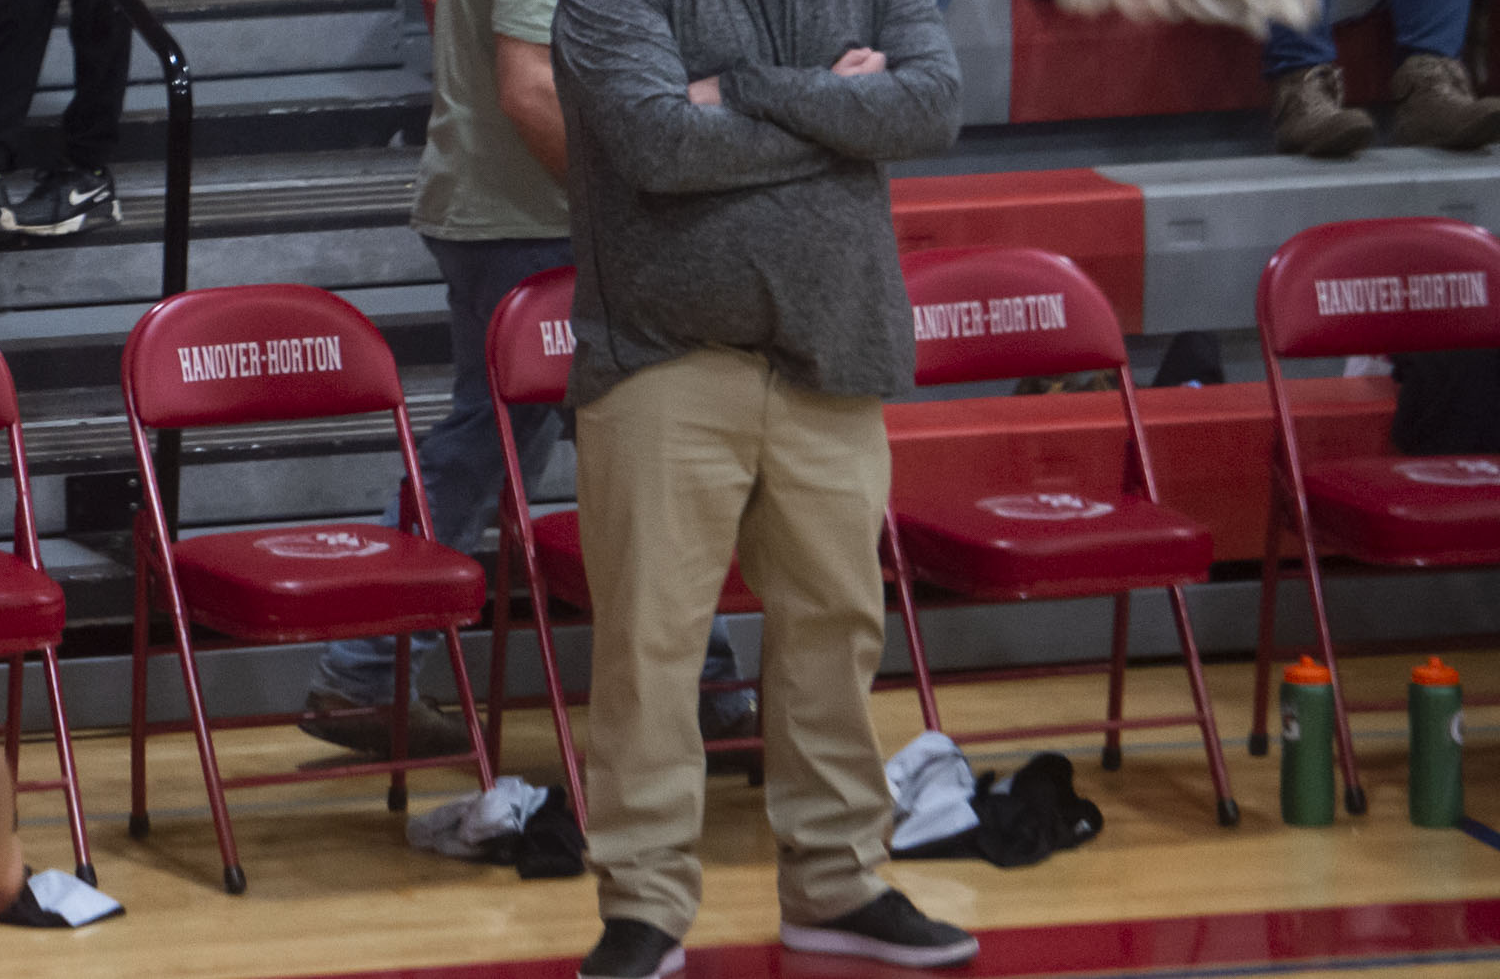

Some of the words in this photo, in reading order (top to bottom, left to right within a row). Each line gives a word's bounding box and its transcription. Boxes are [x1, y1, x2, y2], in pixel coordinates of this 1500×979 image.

[912, 293, 1067, 341] ANOVER-HORTON
[1315, 271, 1489, 317] HANOVER-HORTON
[177, 335, 342, 383] HANOVER-HORTON
